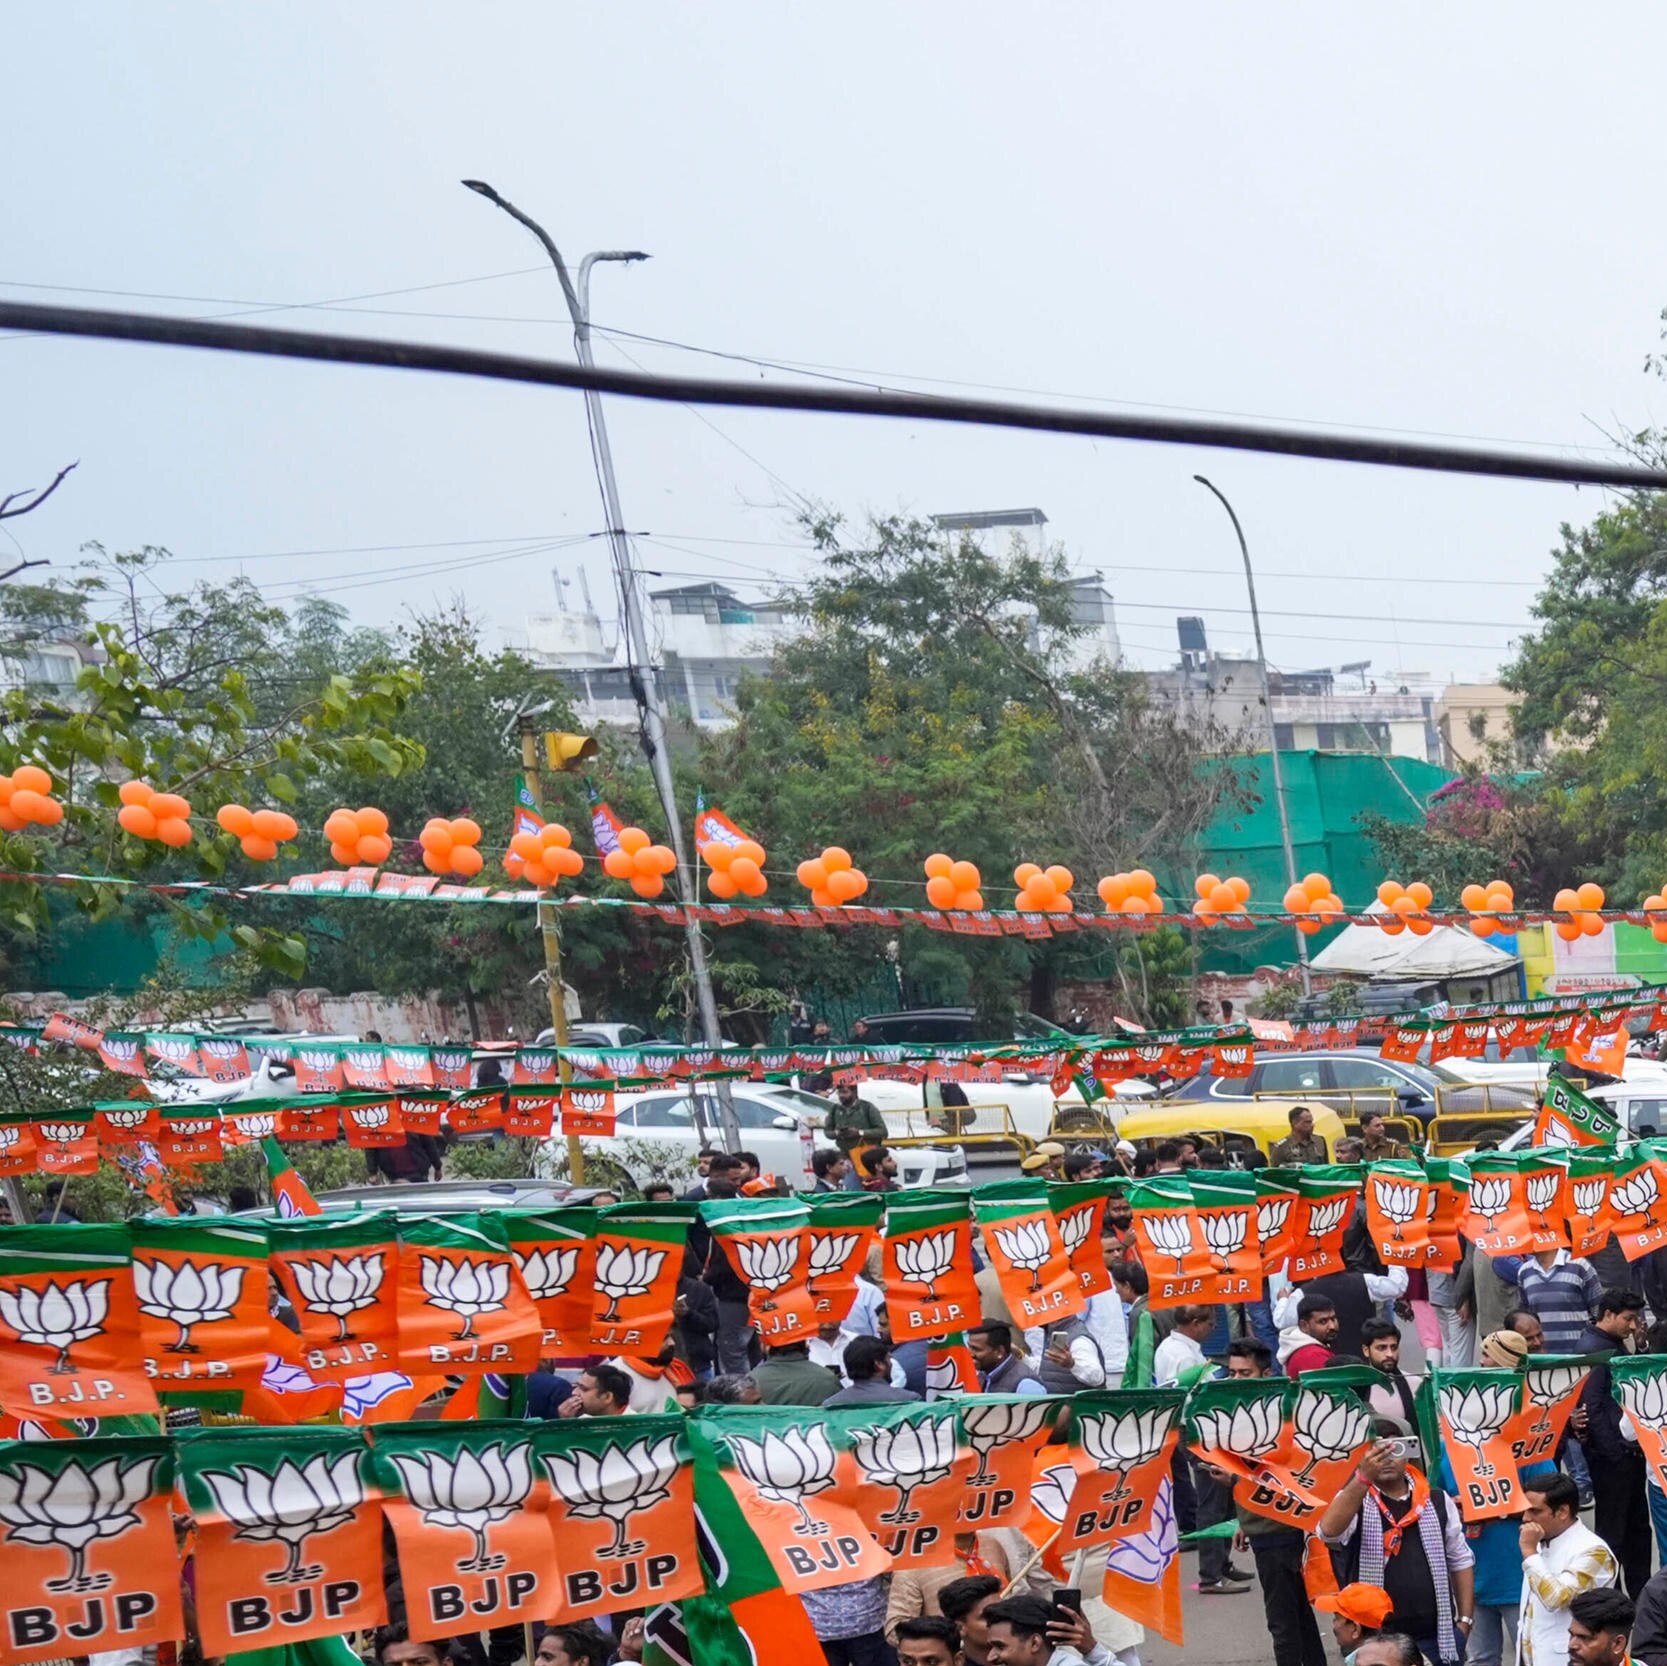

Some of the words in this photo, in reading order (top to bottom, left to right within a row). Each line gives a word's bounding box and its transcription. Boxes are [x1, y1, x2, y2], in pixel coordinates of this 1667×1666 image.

[1474, 1232, 1521, 1250] B.J.P.
[1295, 1253, 1333, 1272] B.J.P.
[1162, 1278, 1204, 1298] B.J.P.
[1217, 1279, 1251, 1295] .J.P.
[909, 1304, 965, 1328] B.J.P.
[1022, 1290, 1069, 1316] B.J.P.
[590, 1329, 641, 1345] .J.P.
[307, 1341, 389, 1370] B.J.P.
[429, 1343, 514, 1364] B.J.P.
[28, 1379, 126, 1405] B.J.P.
[957, 1488, 1015, 1523] JP
[1467, 1477, 1513, 1510] BJP
[1074, 1498, 1143, 1540] BJP
[783, 1535, 862, 1577] BJP
[870, 1524, 939, 1560] JP
[564, 1553, 678, 1606] BJP
[228, 1579, 361, 1637] BJP
[429, 1570, 538, 1623] BJP
[8, 1590, 157, 1649] BJP
